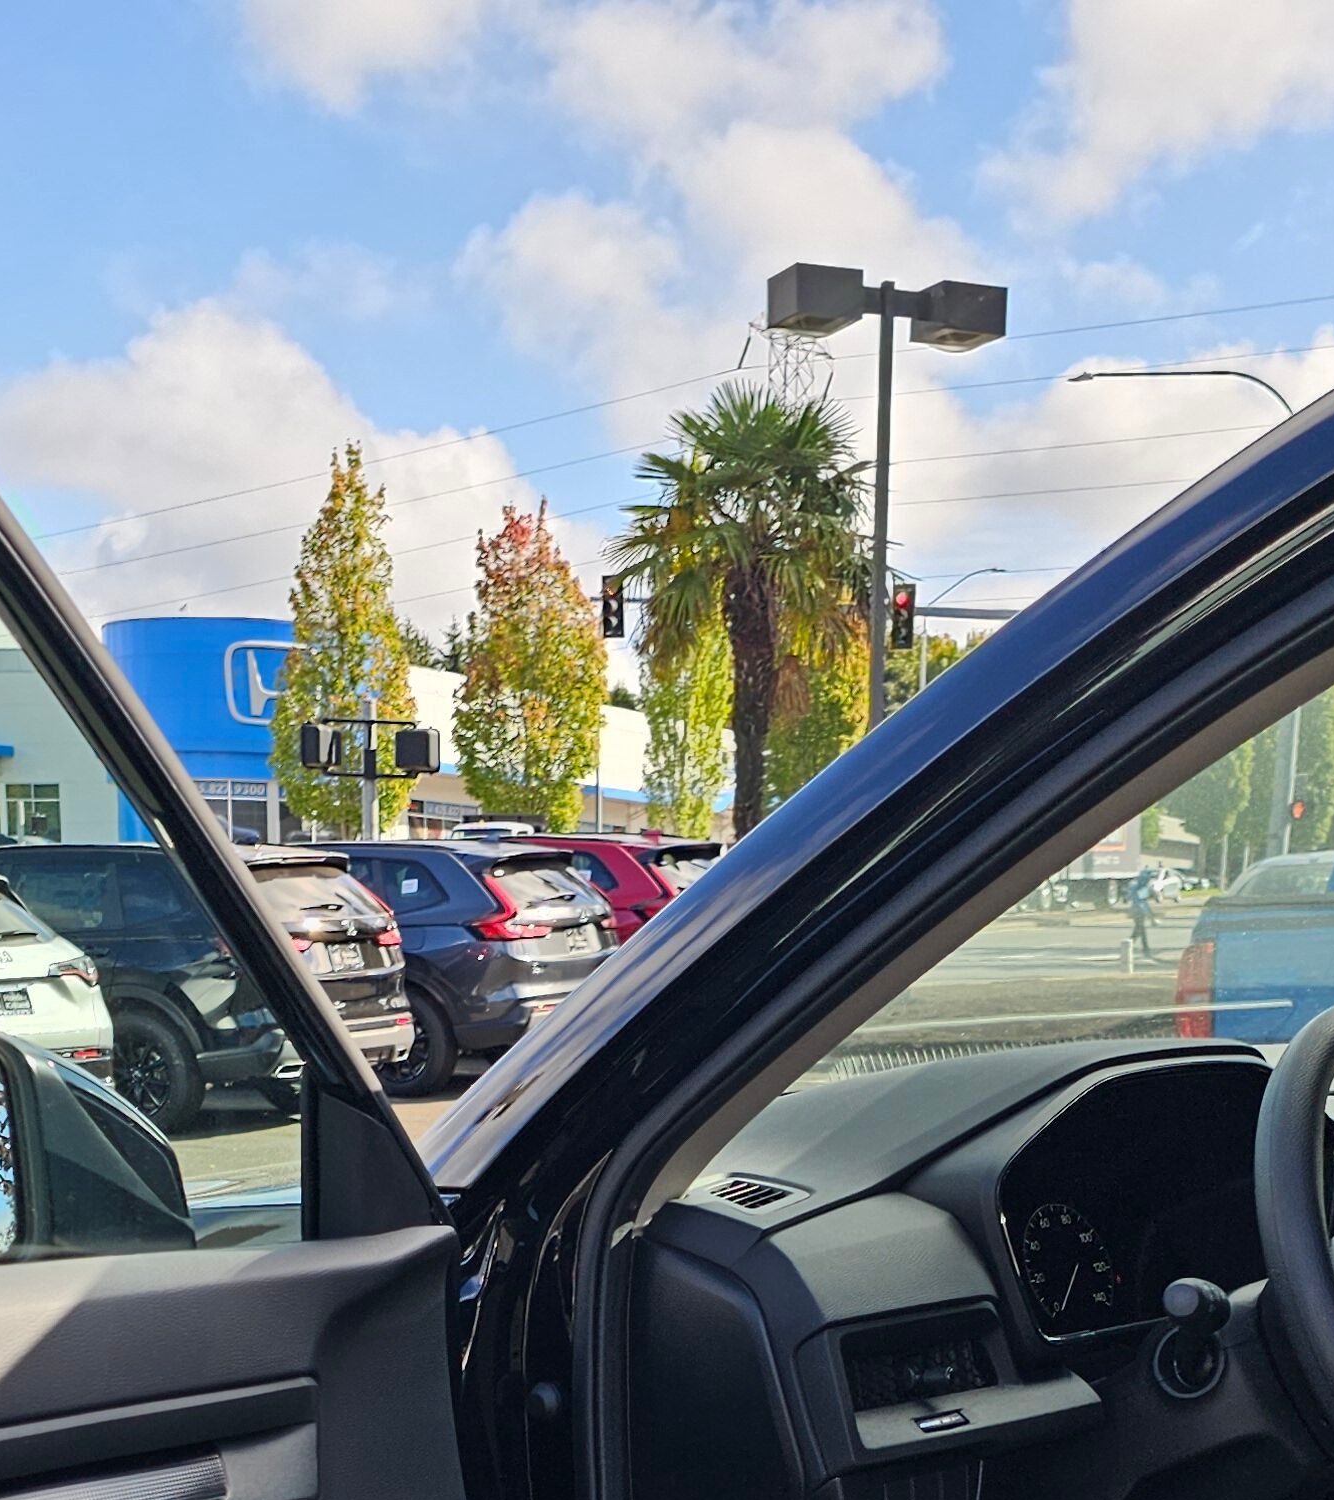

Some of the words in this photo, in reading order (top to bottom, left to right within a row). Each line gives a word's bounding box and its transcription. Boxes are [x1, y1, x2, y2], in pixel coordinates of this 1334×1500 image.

[1040, 1217, 1050, 1229] 60
[1061, 1214, 1072, 1225] 80
[1079, 1232, 1093, 1243] 100
[1030, 1240, 1041, 1251] 40
[1093, 1261, 1107, 1273] 120
[1034, 1272, 1046, 1284] 20
[1093, 1291, 1107, 1302] 140
[1053, 1301, 1060, 1312] 0
